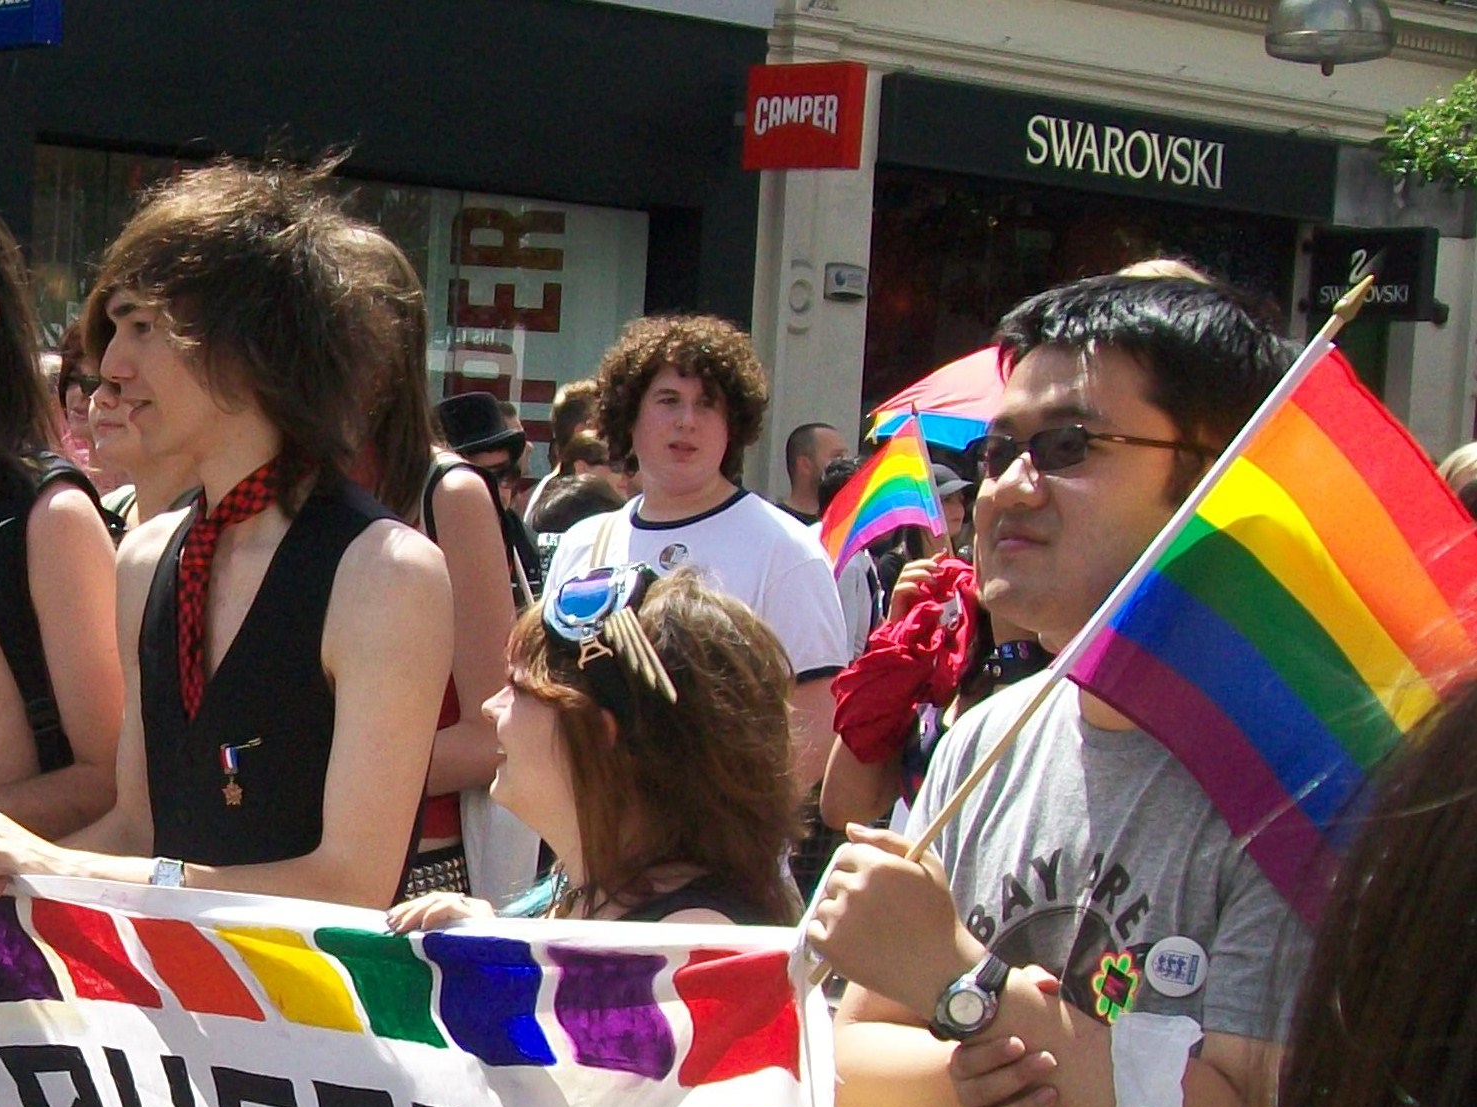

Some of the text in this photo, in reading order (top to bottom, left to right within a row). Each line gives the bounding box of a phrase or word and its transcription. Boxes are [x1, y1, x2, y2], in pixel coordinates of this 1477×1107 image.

[754, 94, 839, 136] CAMPER
[1026, 114, 1225, 190] SWAROVSKI
[1320, 284, 1410, 303] SWOVSKI
